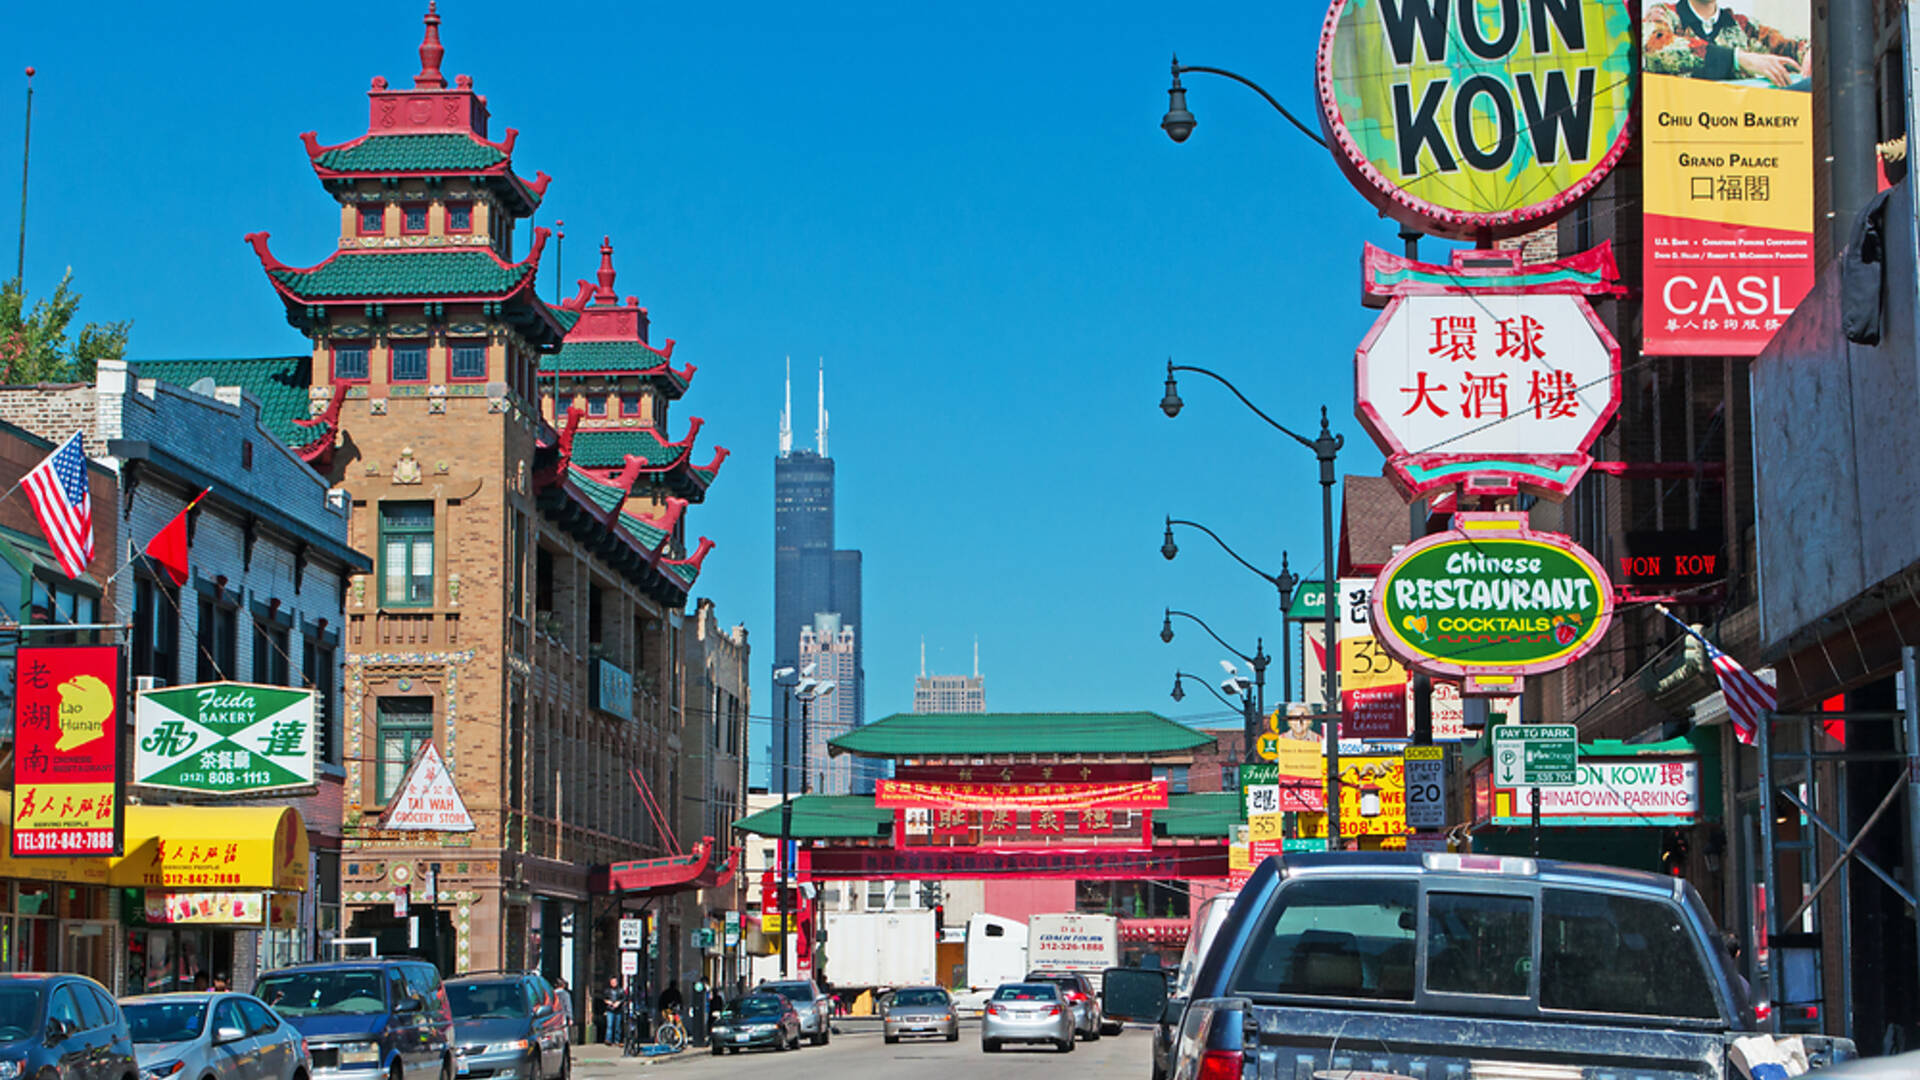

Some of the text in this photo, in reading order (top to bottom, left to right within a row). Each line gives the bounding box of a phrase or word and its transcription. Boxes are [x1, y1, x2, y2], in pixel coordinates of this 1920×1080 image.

[1380, 0, 1586, 67] WON
[1392, 67, 1597, 178] KOW
[1658, 112, 1800, 129] CHIU QUON BAKERY
[1678, 153, 1778, 168] GRAND PALACE
[1691, 174, 1770, 201] 口福閣
[1663, 276, 1796, 315] CASL
[1428, 315, 1546, 362] 環球
[1400, 370, 1580, 420] 大酒樓
[1446, 551, 1542, 574] Chinese
[1620, 555, 1716, 577] WON KOW
[1395, 578, 1592, 611] RESTAURANT
[1437, 616, 1550, 632] COCKTAILS
[1353, 640, 1393, 674] 35
[61, 703, 83, 714] Lao
[197, 688, 256, 712] Feida
[22, 659, 51, 774] 老湖南
[61, 718, 102, 731] Hunan
[199, 711, 256, 724] BAKERY
[1500, 728, 1570, 738] PAY TO PARK
[1407, 748, 1439, 758] SCHOOL
[1408, 762, 1440, 771] SPEED
[180, 773, 204, 783] (312)
[1411, 773, 1437, 782] LIMIT
[1576, 766, 1657, 785] ON KOW
[1410, 784, 1440, 802] 20
[1526, 790, 1689, 807] CHINATOWN PARKING
[408, 798, 454, 811] TAI WAH
[395, 811, 465, 824] GROCERY STORE
